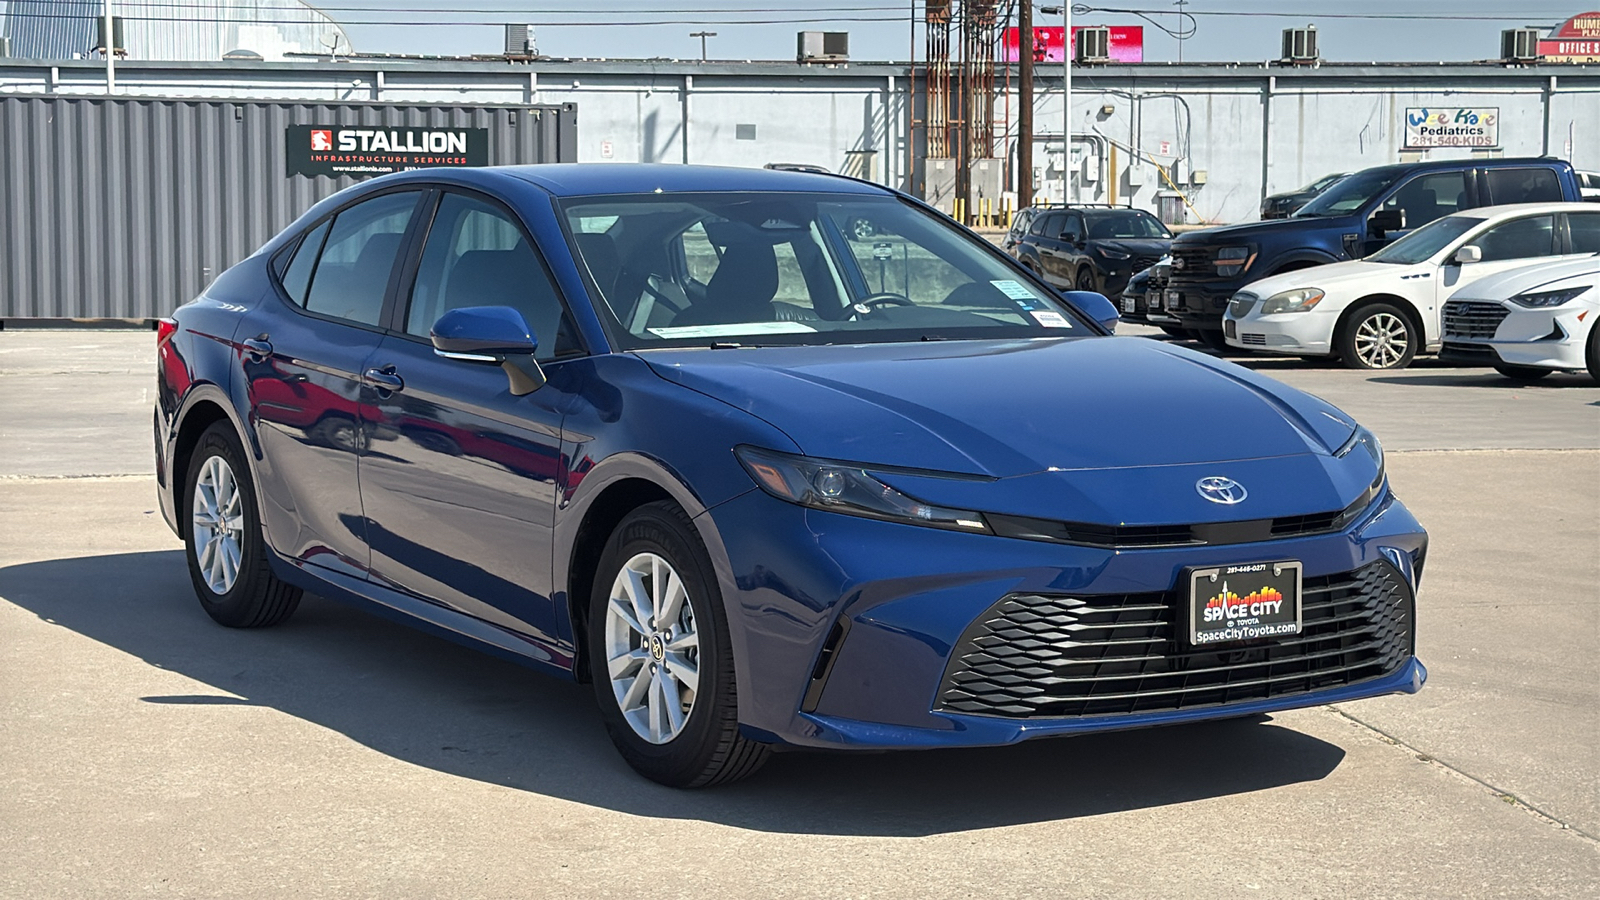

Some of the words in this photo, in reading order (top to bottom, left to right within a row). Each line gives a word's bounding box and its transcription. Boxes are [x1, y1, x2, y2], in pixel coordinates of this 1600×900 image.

[1559, 42, 1591, 54] OFFICE
[1408, 107, 1450, 127] Wee
[1454, 108, 1496, 126] Kare
[1420, 126, 1484, 136] Pediatrics
[338, 130, 467, 153] STALLION
[1412, 136, 1492, 146] 281-540-KIDS
[311, 155, 408, 164] INFRASTRUCTURE
[414, 156, 467, 165] SERVICES
[1203, 602, 1248, 622] SPACE
[1250, 600, 1283, 616] CITY
[1236, 617, 1260, 627] TOYOTA
[1197, 623, 1297, 643] SpaceCityToyota.com
